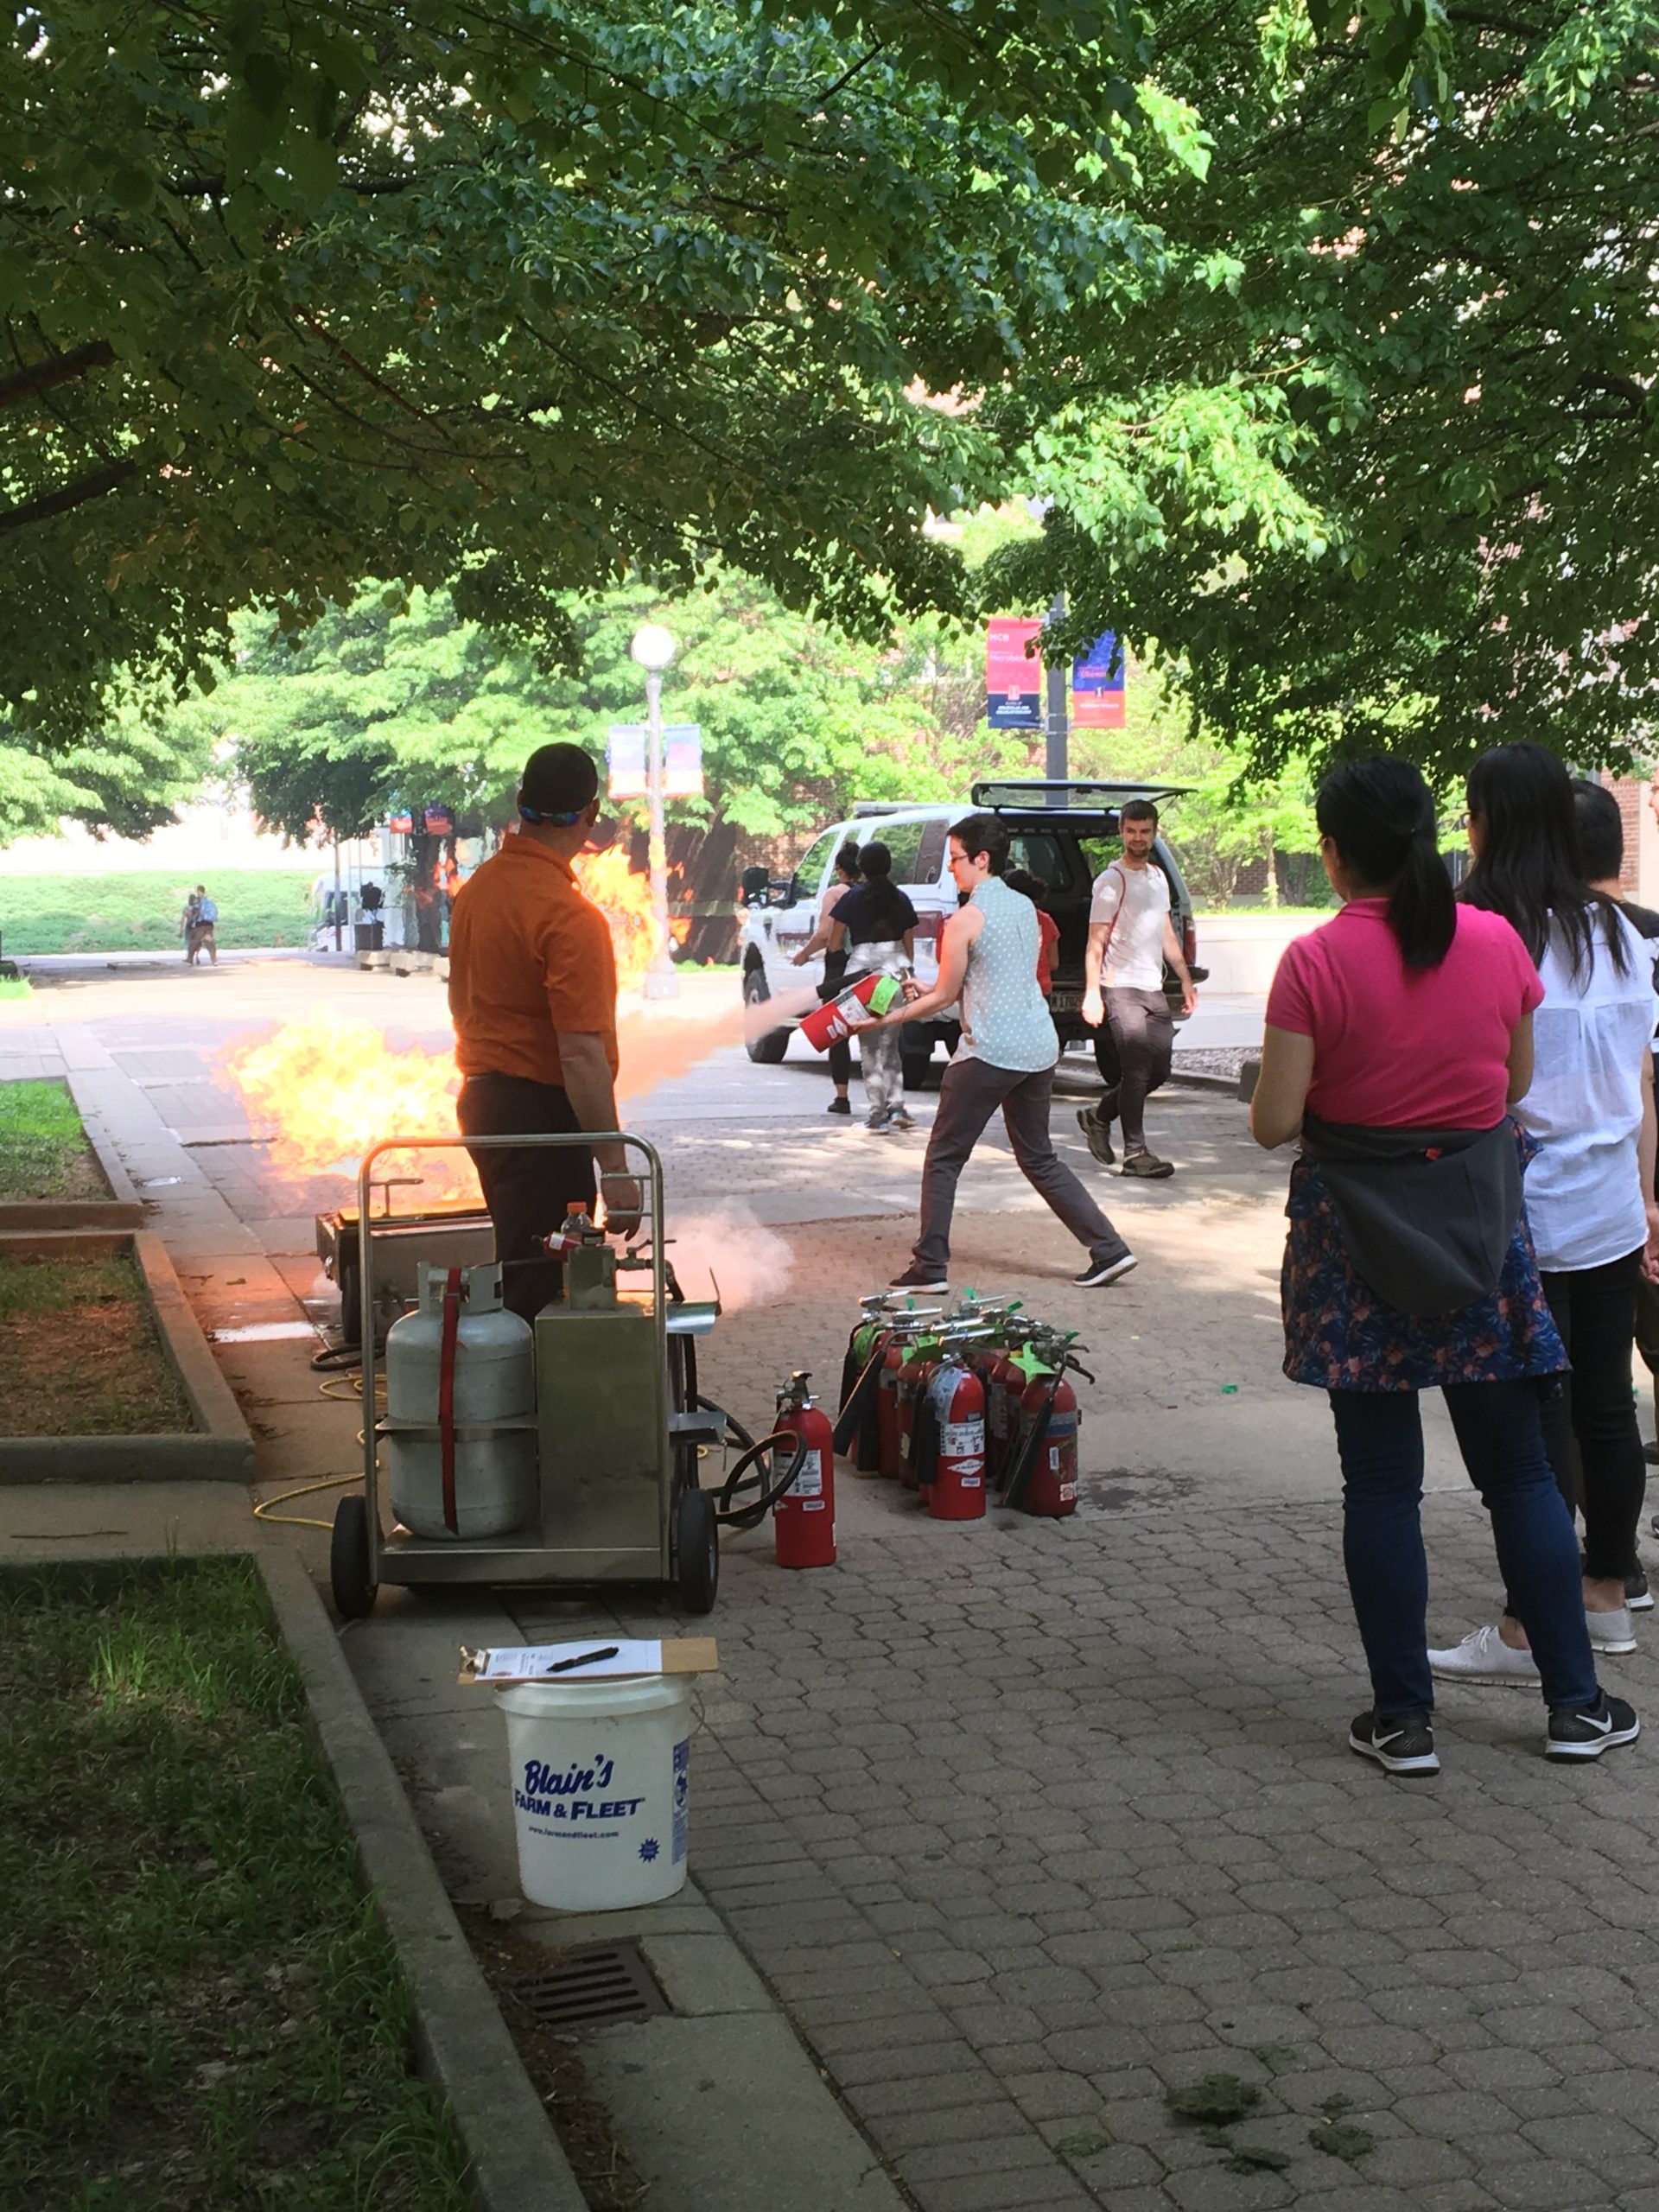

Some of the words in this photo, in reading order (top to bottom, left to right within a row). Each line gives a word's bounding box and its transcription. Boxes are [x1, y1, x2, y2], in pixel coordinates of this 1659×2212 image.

[990, 633, 1009, 642] MCB
[524, 1754, 614, 1796] Blain's
[514, 1788, 551, 1816] FARM
[553, 1803, 567, 1819] &
[570, 1798, 643, 1821] FLEET
